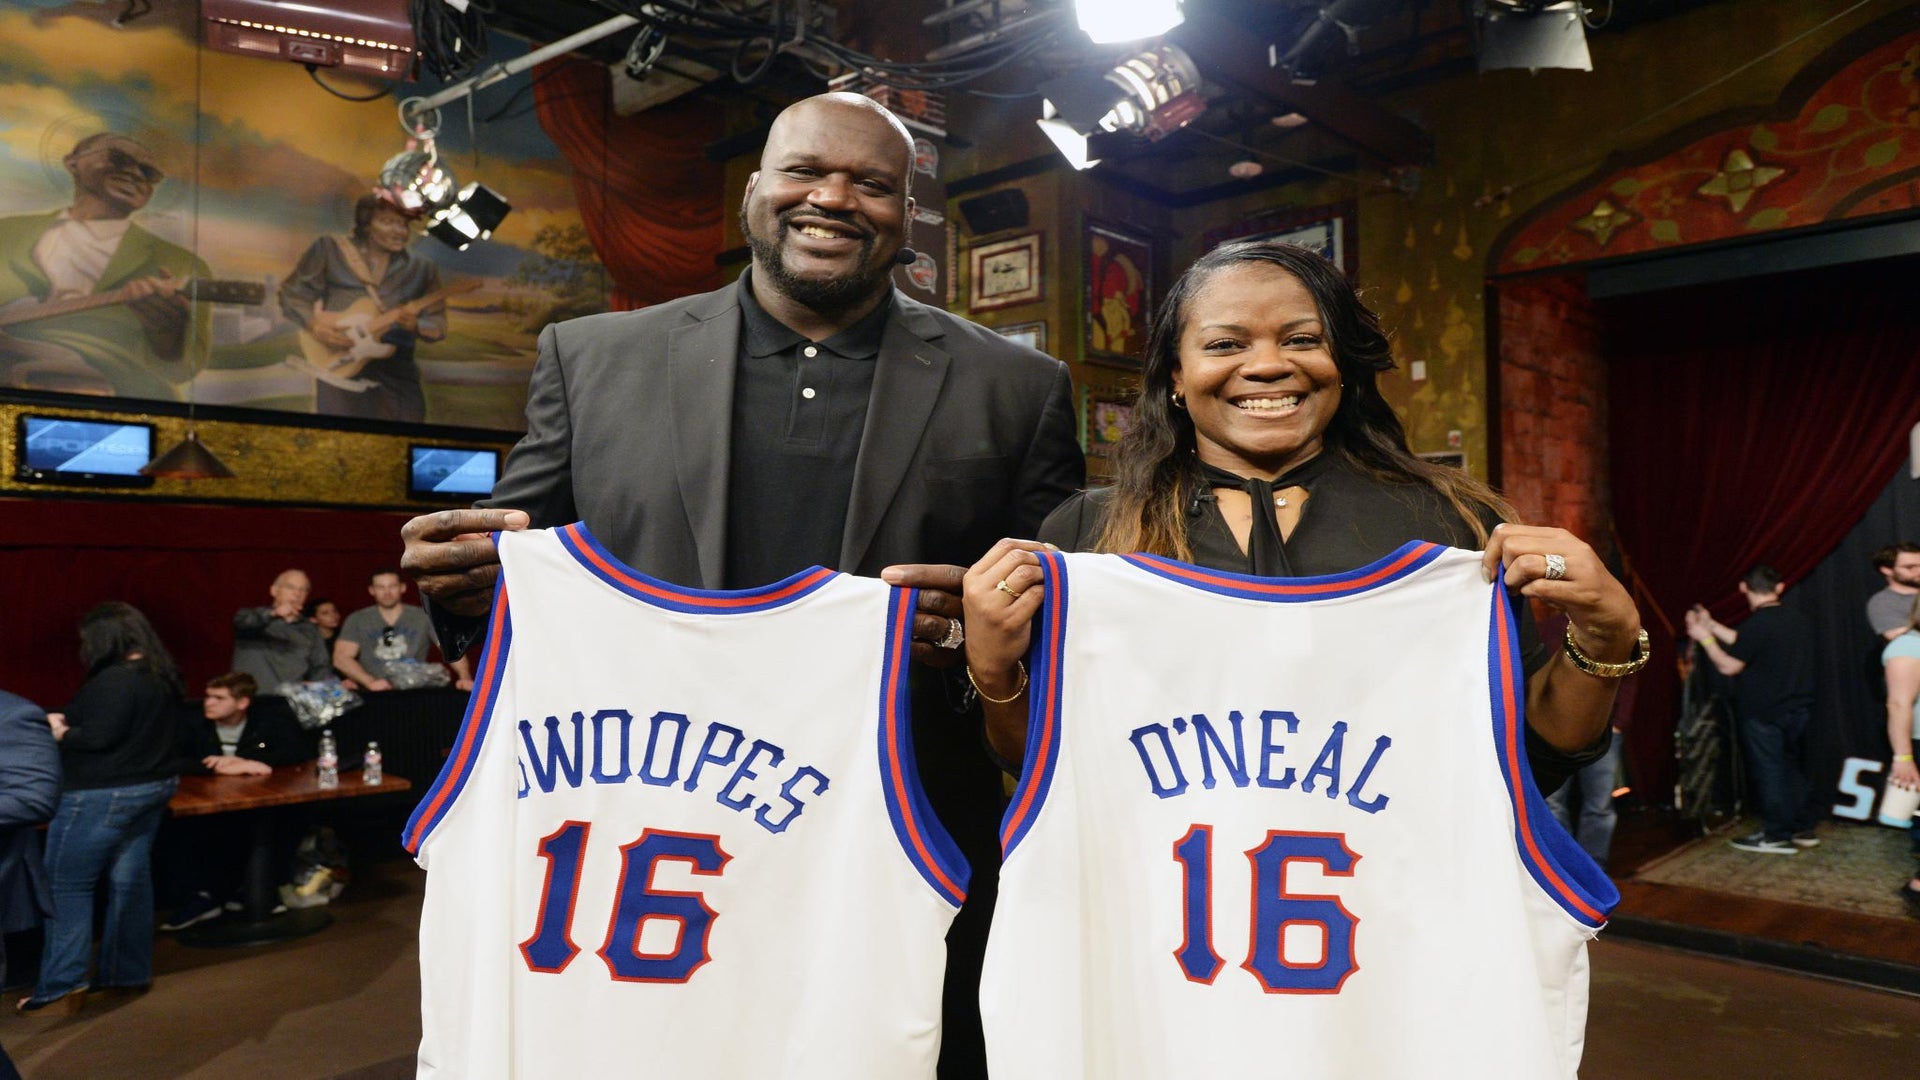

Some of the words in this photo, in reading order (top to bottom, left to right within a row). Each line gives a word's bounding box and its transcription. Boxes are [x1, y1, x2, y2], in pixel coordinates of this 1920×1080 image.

[1128, 710, 1392, 814] O'NEAL
[518, 820, 734, 984] 16
[1172, 823, 1363, 995] 16
